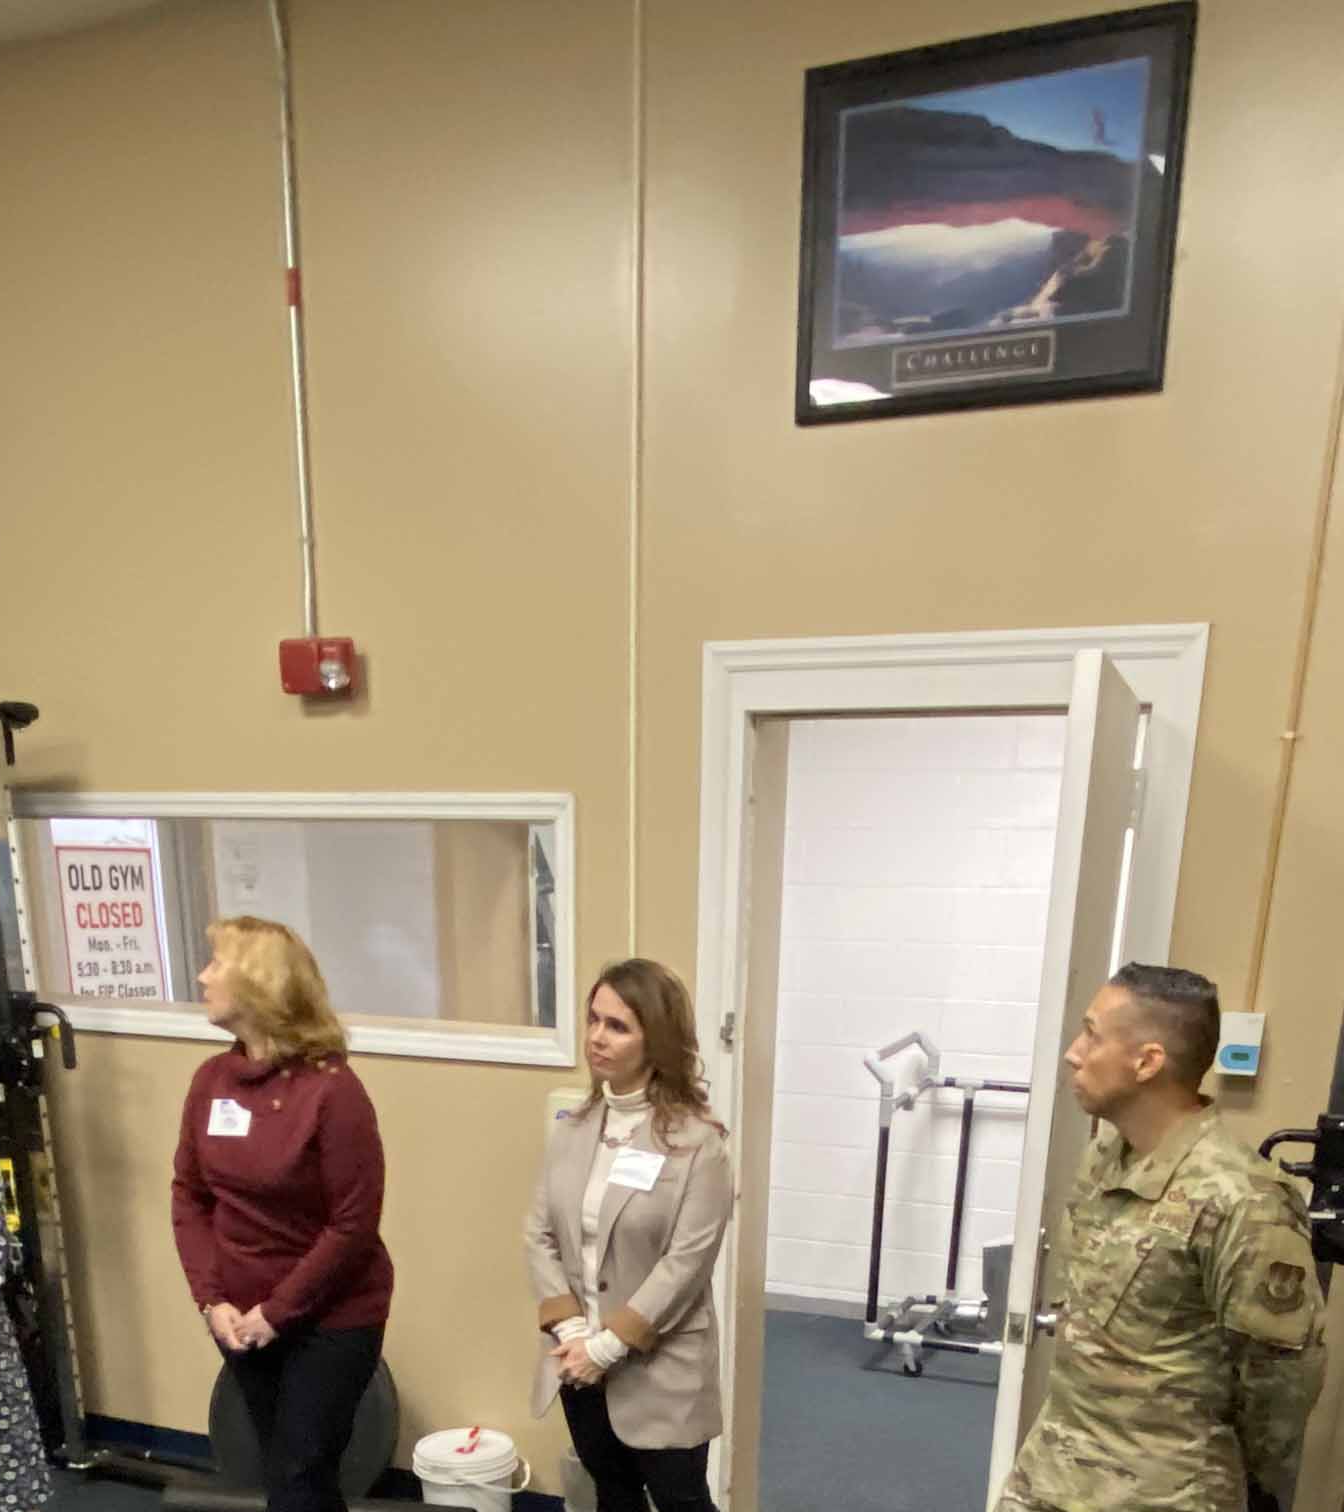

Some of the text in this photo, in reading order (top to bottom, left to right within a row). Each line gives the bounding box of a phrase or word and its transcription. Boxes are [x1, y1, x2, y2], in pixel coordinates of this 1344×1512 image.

[906, 342, 1040, 370] CHALLENGE
[67, 863, 146, 892] OLD GYM
[76, 901, 145, 930] CLOSED
